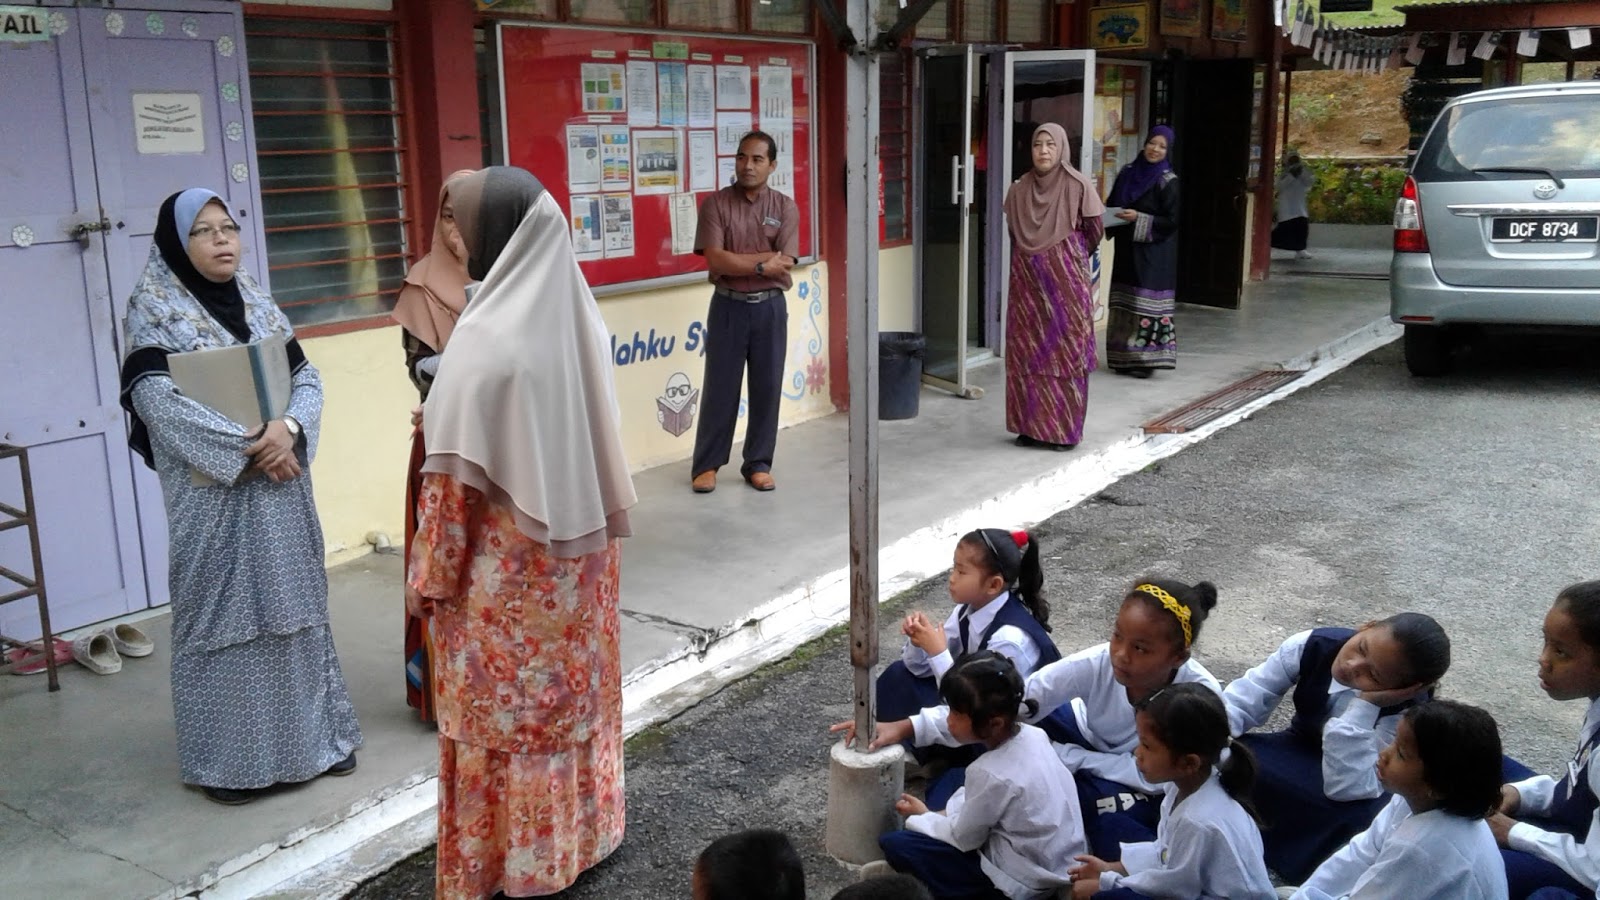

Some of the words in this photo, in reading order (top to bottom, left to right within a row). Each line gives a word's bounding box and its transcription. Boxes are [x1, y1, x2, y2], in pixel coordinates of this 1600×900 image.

[0, 14, 43, 35] AIL
[1509, 222, 1538, 237] DCF
[1542, 222, 1578, 237] 8734
